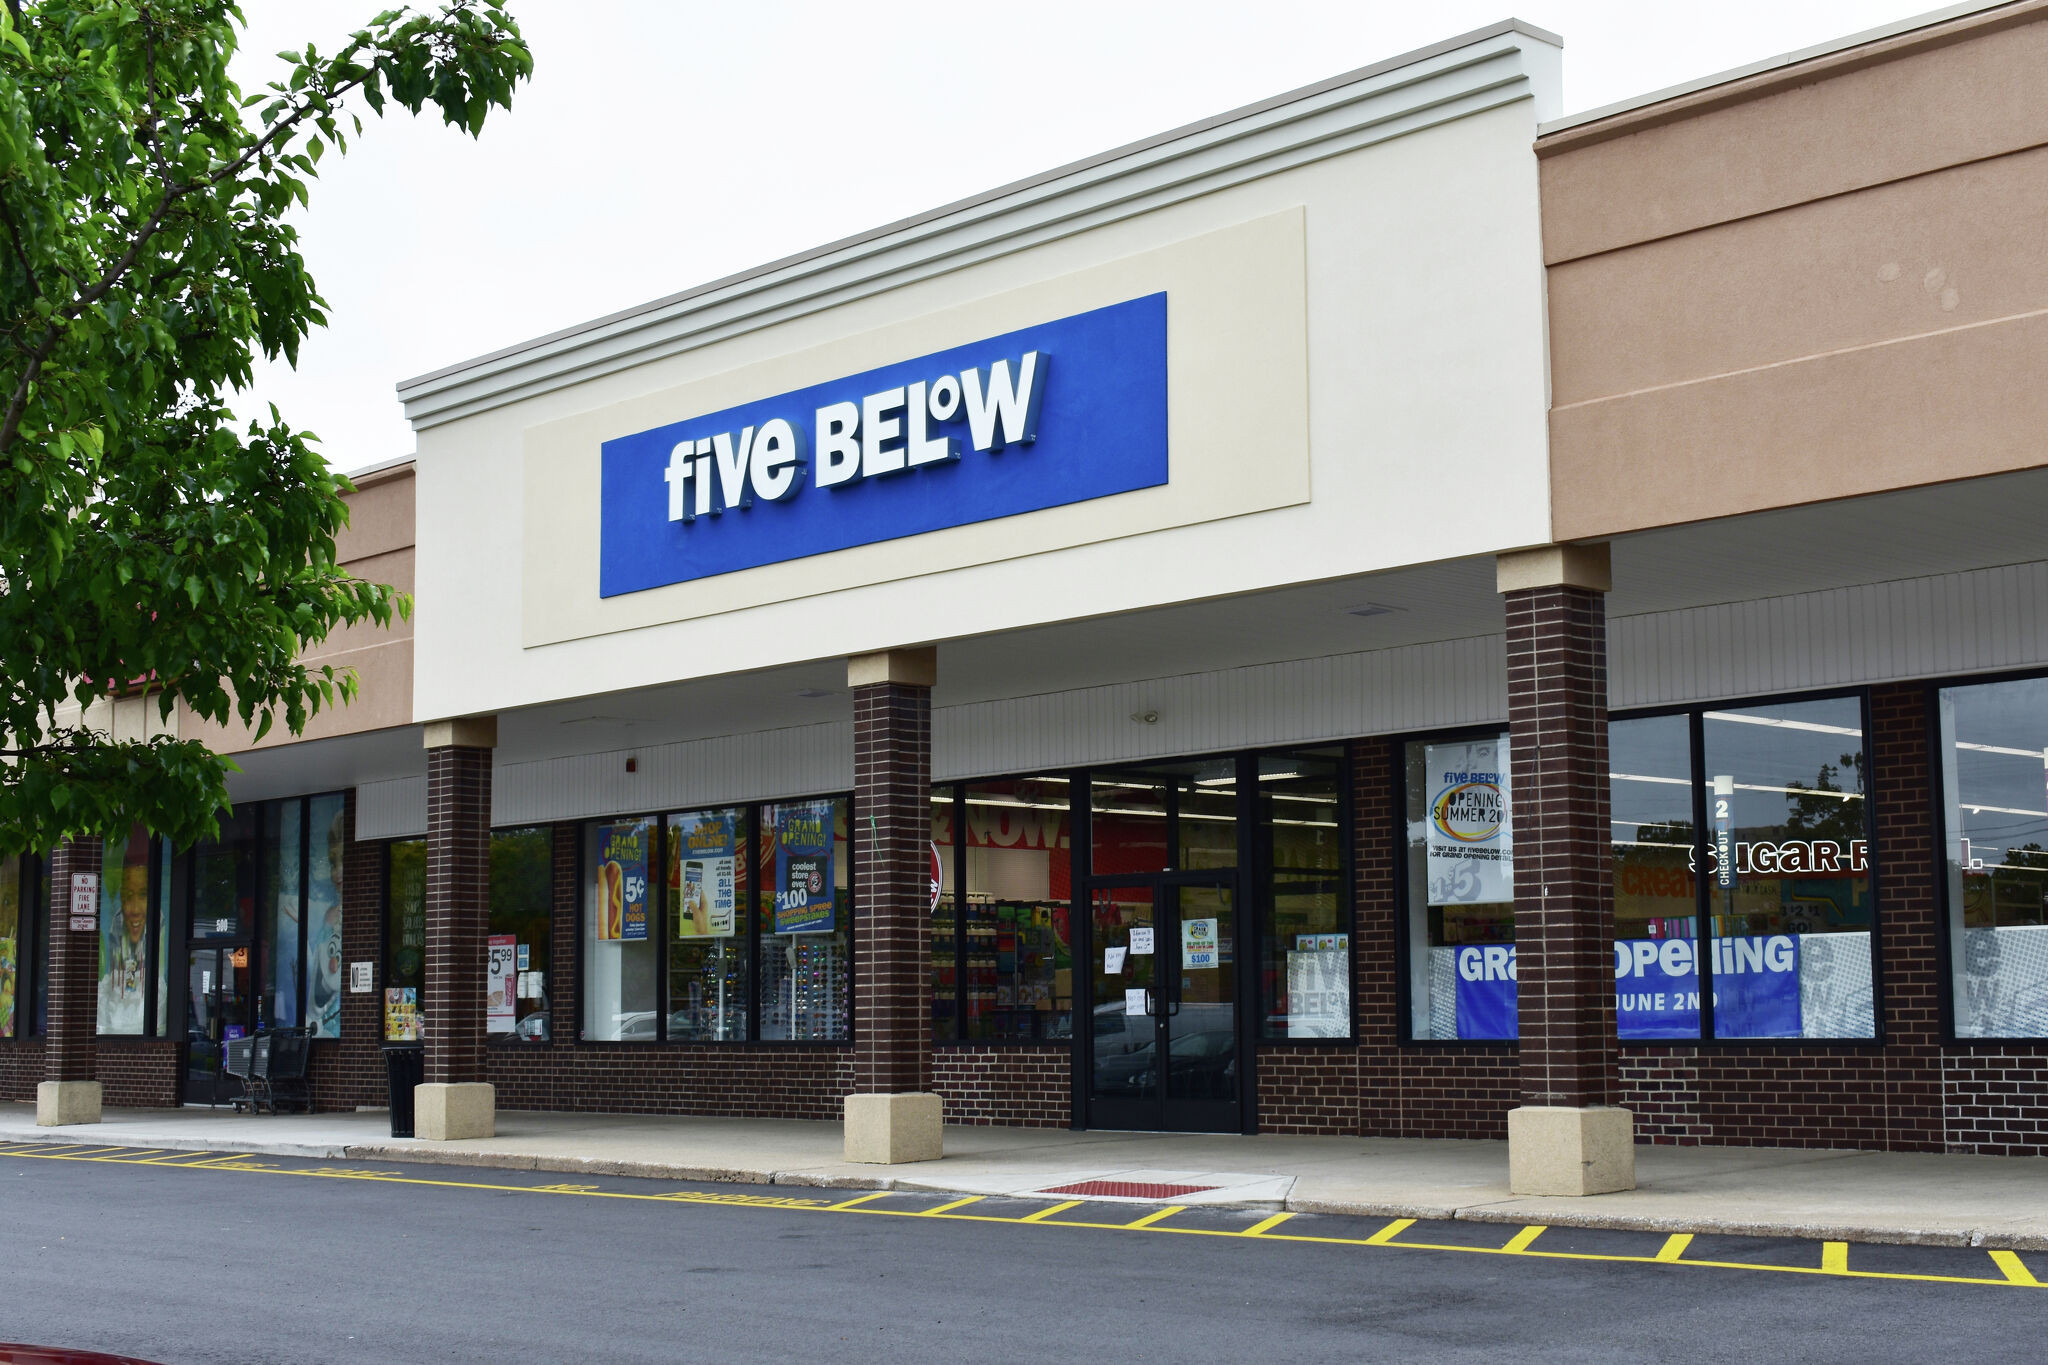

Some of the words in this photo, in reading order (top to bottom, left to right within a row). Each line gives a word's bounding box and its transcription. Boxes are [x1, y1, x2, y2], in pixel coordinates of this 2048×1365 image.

[1449, 792, 1503, 808] OPENING
[1433, 806, 1486, 823] SUMMER
[1715, 800, 1729, 818] 2
[694, 821, 722, 837] SHOP
[787, 819, 821, 833] GRAND
[610, 834, 639, 849] GRAND
[781, 831, 827, 847] OPENING!
[1719, 829, 1730, 886] CHECKOUT
[791, 862, 817, 871] coolest
[81, 876, 89, 885] NO
[791, 871, 809, 880] store
[625, 876, 645, 903] 5¢
[791, 881, 807, 889] ever.
[78, 894, 90, 902] FIRE
[776, 888, 808, 910] $100
[77, 903, 90, 911] LANE
[629, 903, 643, 913] HOT
[216, 918, 228, 932] 500
[625, 913, 646, 923] DOGS
[1191, 954, 1210, 963] $100
